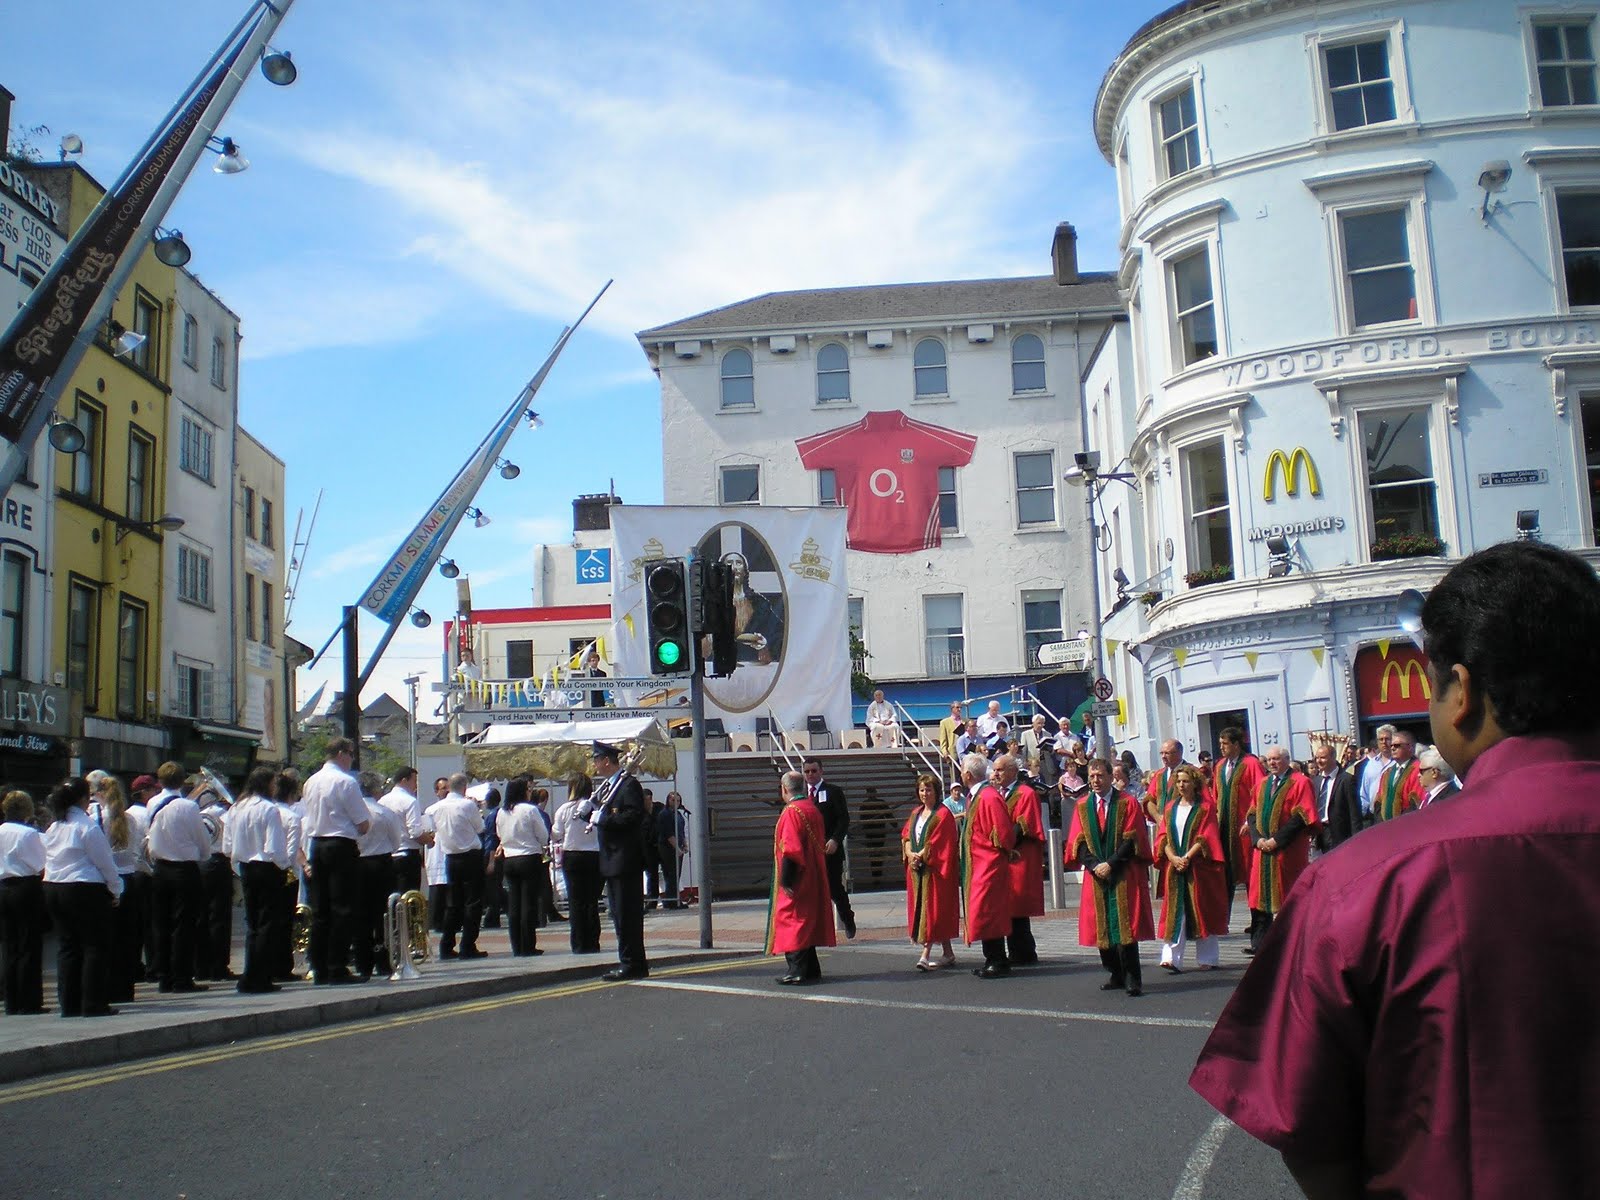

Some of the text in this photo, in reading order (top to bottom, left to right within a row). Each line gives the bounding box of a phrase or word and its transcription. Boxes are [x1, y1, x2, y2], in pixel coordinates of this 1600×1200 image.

[25, 236, 52, 268] HIRE
[1248, 517, 1344, 541] McDonald's
[1050, 640, 1086, 652] SAMARITANS
[616, 680, 634, 688] Your
[535, 713, 559, 722] Mercy
[584, 711, 608, 719] Christ
[610, 711, 631, 719] Have
[25, 735, 48, 751] Hire
